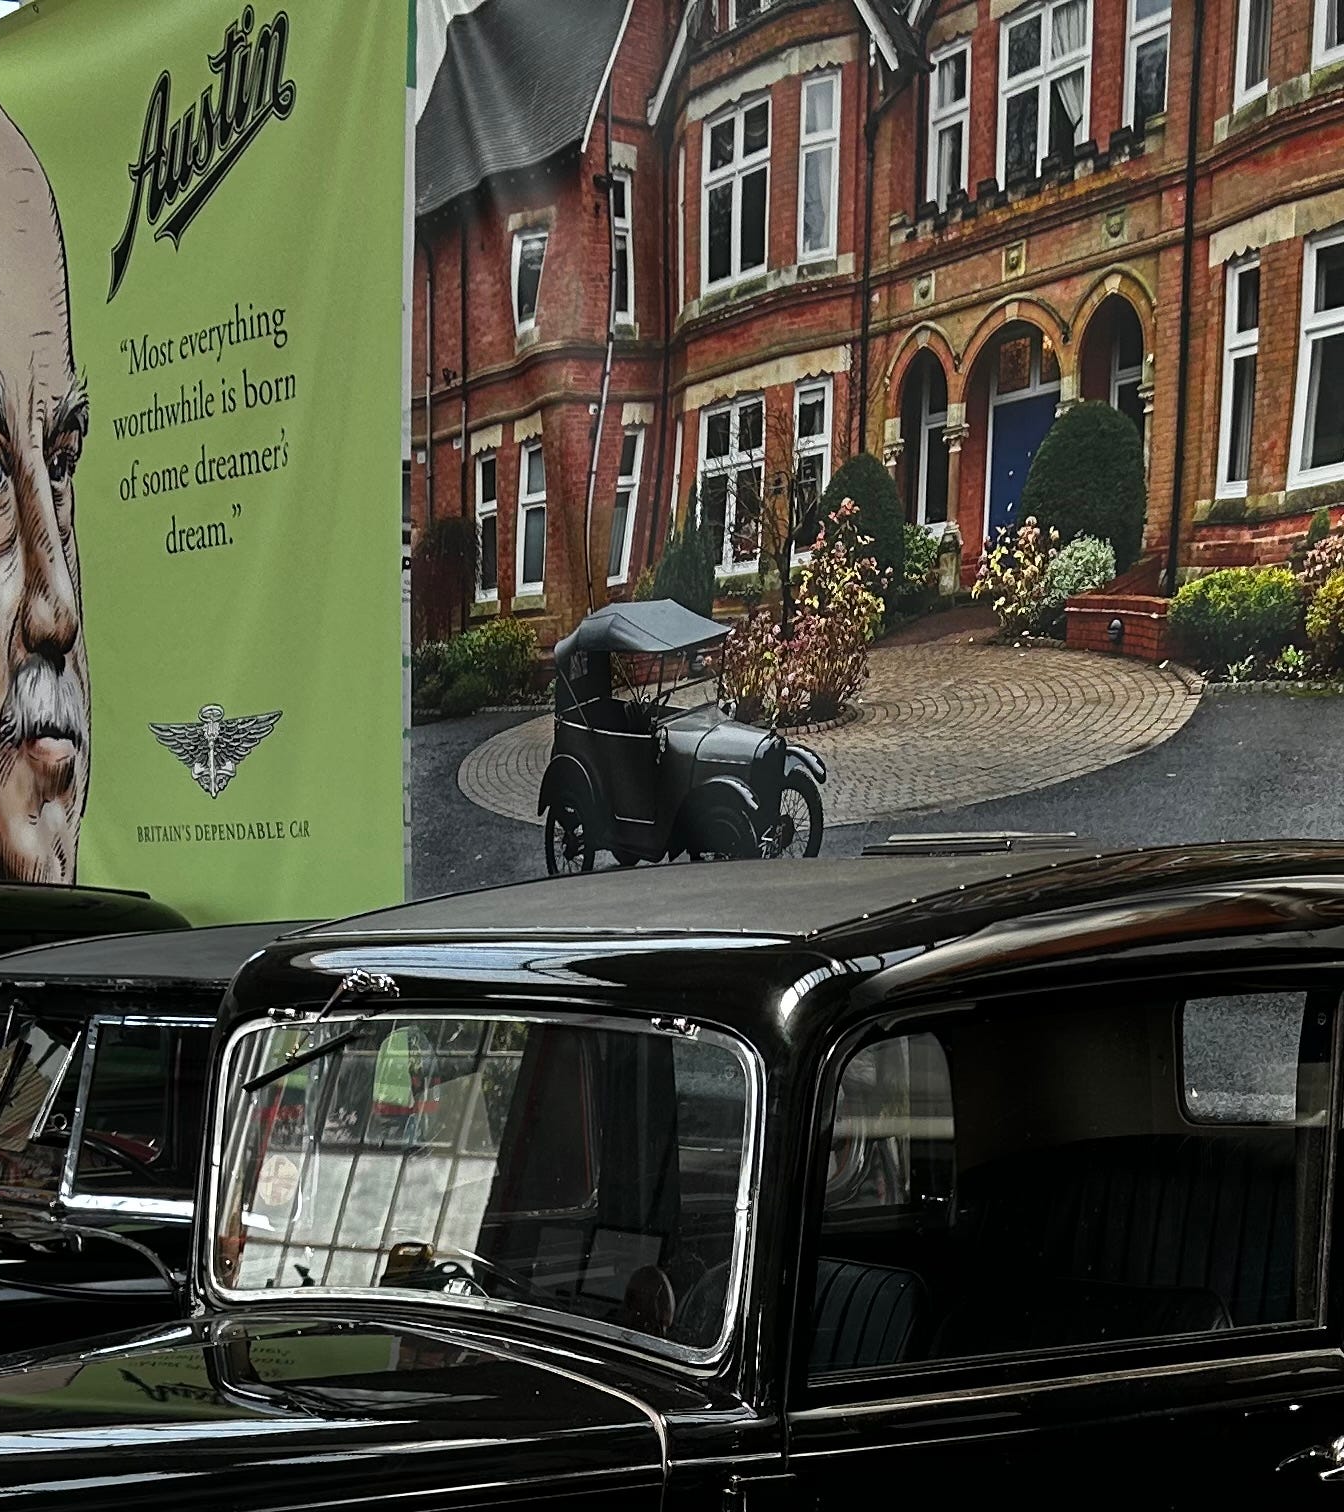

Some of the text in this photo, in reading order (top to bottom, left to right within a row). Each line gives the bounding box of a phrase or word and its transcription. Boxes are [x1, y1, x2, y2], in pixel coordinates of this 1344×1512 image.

[107, 5, 297, 304] Austin
[179, 303, 288, 362] everything
[113, 368, 296, 441] worthwhile is born
[120, 460, 140, 502] of
[143, 463, 189, 497] some
[136, 820, 311, 843] BRITAIN'S DEPENDABLE CAR
